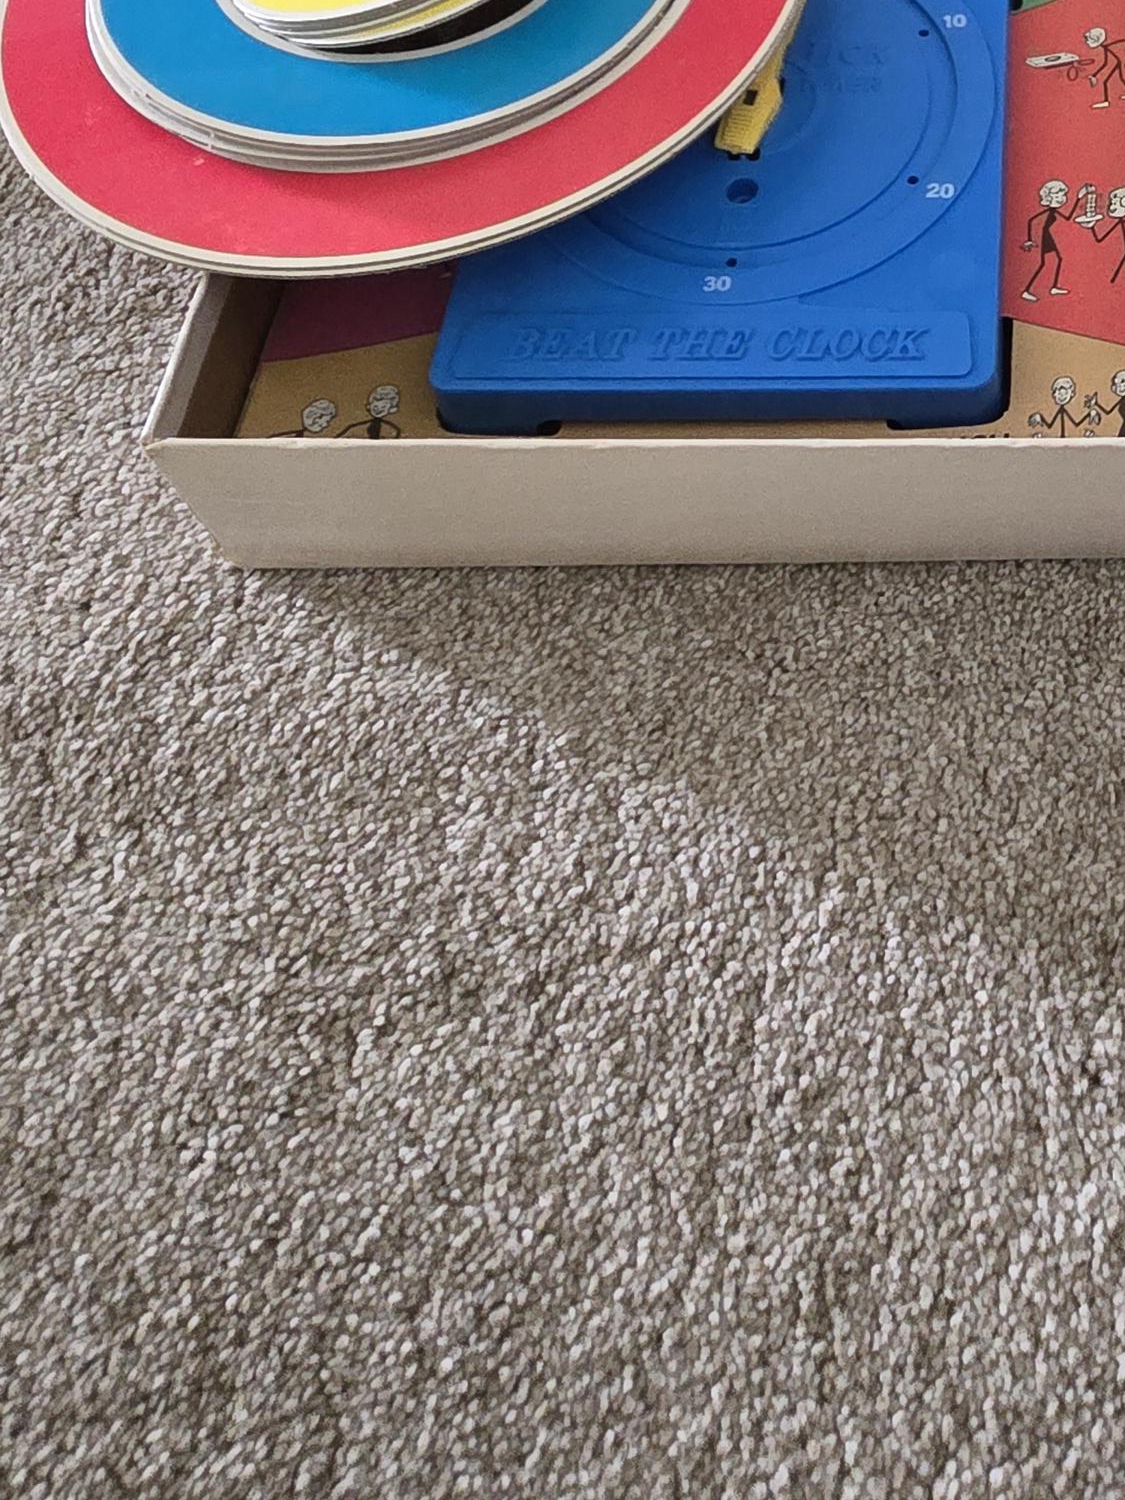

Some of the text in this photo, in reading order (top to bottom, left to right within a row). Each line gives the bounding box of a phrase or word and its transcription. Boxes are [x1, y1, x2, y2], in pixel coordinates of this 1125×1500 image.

[943, 14, 967, 28] 10
[925, 183, 955, 198] 20
[703, 275, 731, 292] 30
[510, 326, 931, 363] BEAT THE CLOCK
